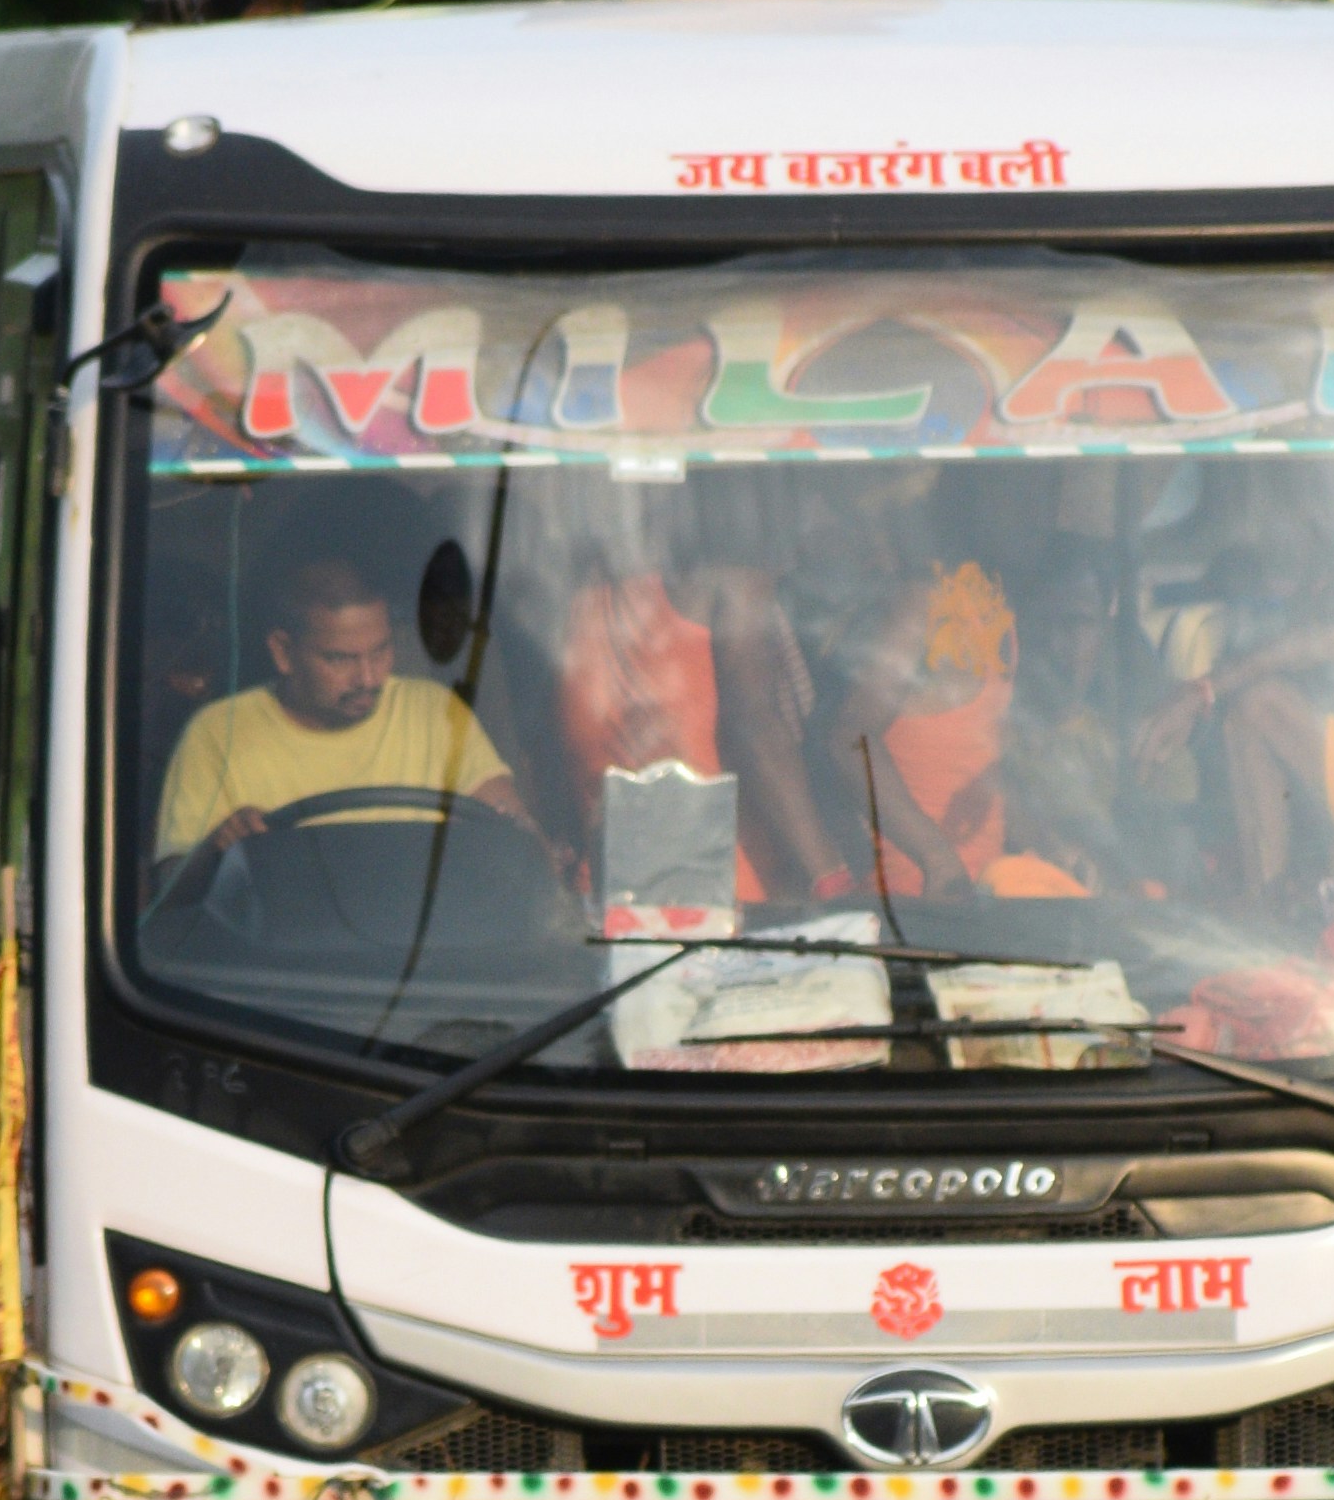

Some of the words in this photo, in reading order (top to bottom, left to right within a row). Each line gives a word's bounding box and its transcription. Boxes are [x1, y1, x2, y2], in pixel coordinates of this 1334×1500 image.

[670, 152, 770, 189] जय
[781, 141, 946, 187] बजरंग
[954, 140, 1070, 186] बली
[757, 1160, 1057, 1202] Marcopolo
[570, 1263, 682, 1339] शुभ
[1113, 1257, 1251, 1313] लाभ
